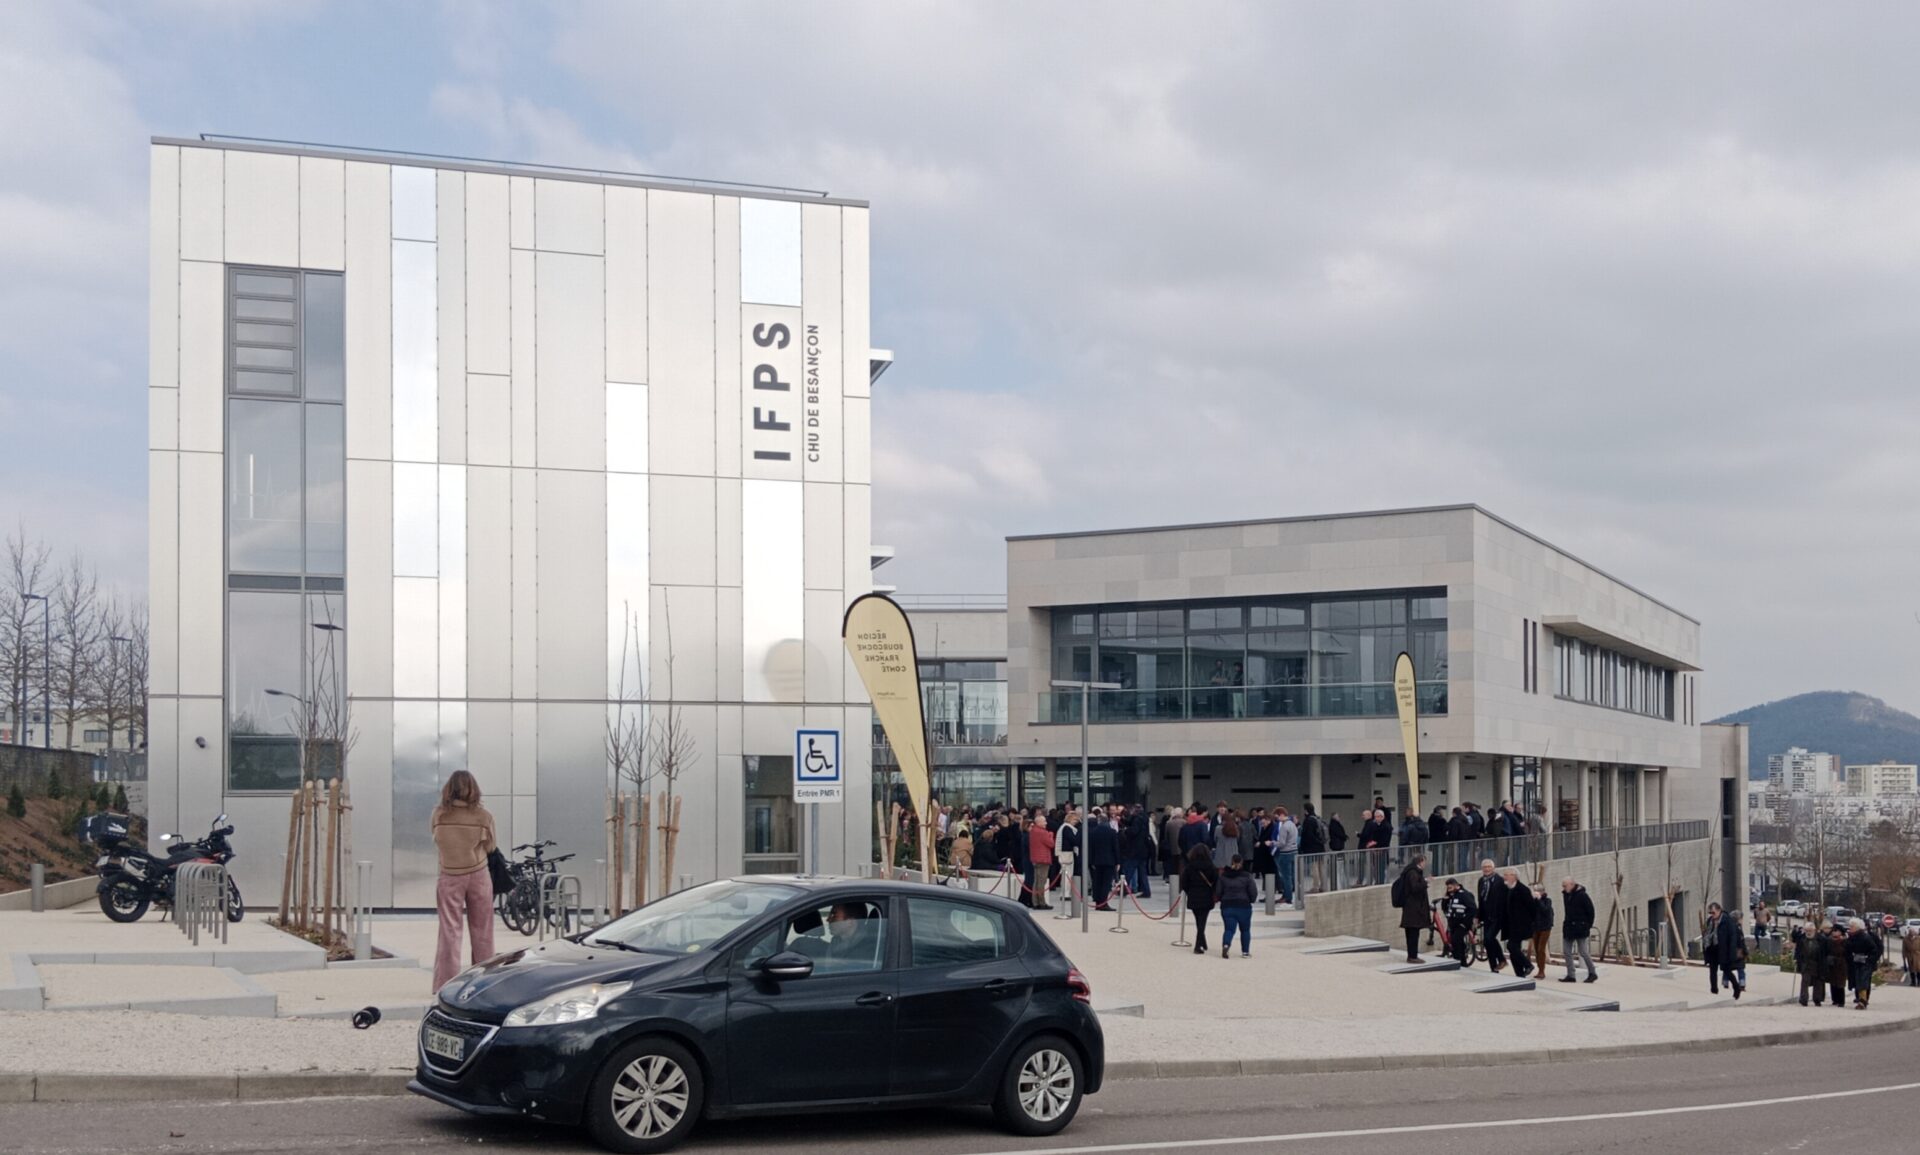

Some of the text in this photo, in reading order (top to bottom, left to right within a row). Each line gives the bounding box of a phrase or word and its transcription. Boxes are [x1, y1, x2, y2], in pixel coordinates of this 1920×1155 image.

[752, 322, 792, 462] IFPS
[807, 324, 822, 463] CHU DE BESANÇON
